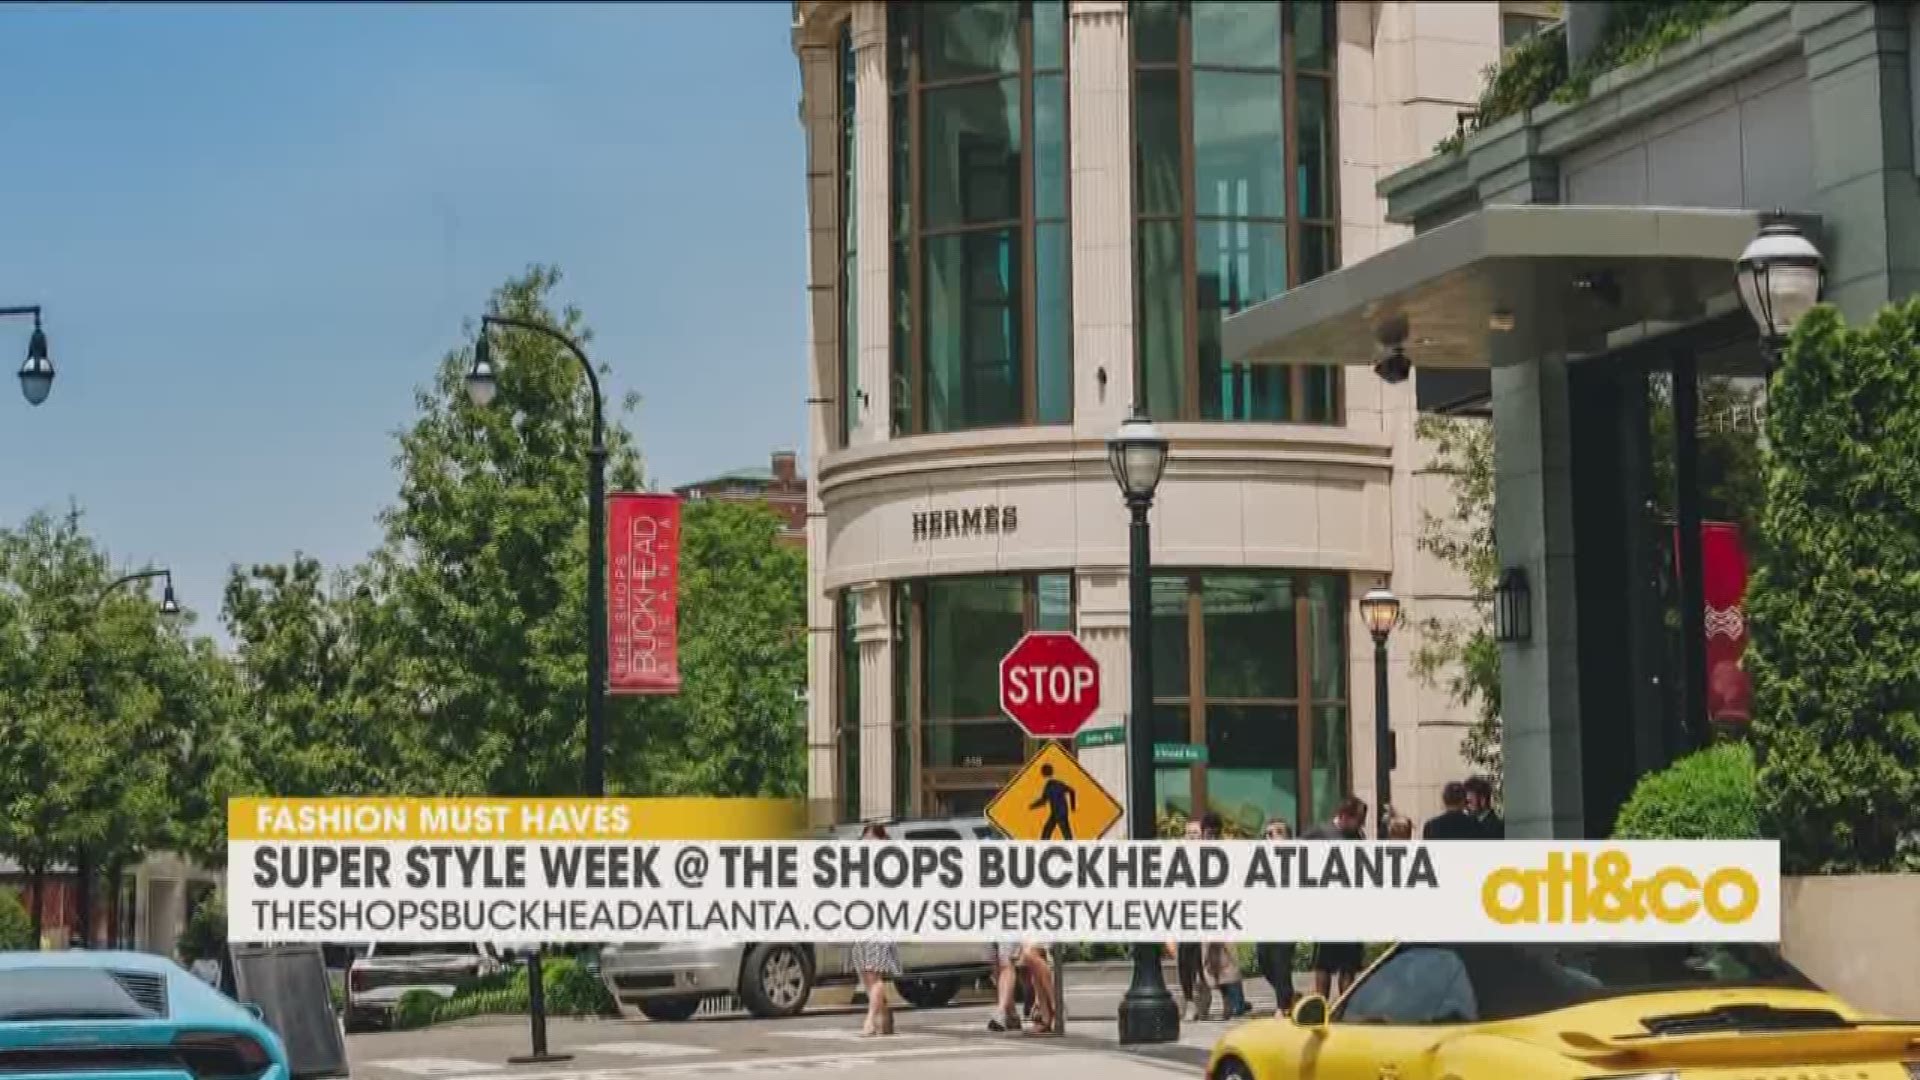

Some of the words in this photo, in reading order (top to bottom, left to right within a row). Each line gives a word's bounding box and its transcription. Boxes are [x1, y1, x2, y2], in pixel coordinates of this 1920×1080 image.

[614, 553, 627, 624] SHOPS
[631, 516, 657, 673] BUCKHEAD
[614, 634, 627, 674] THE
[1008, 666, 1095, 704] STOP
